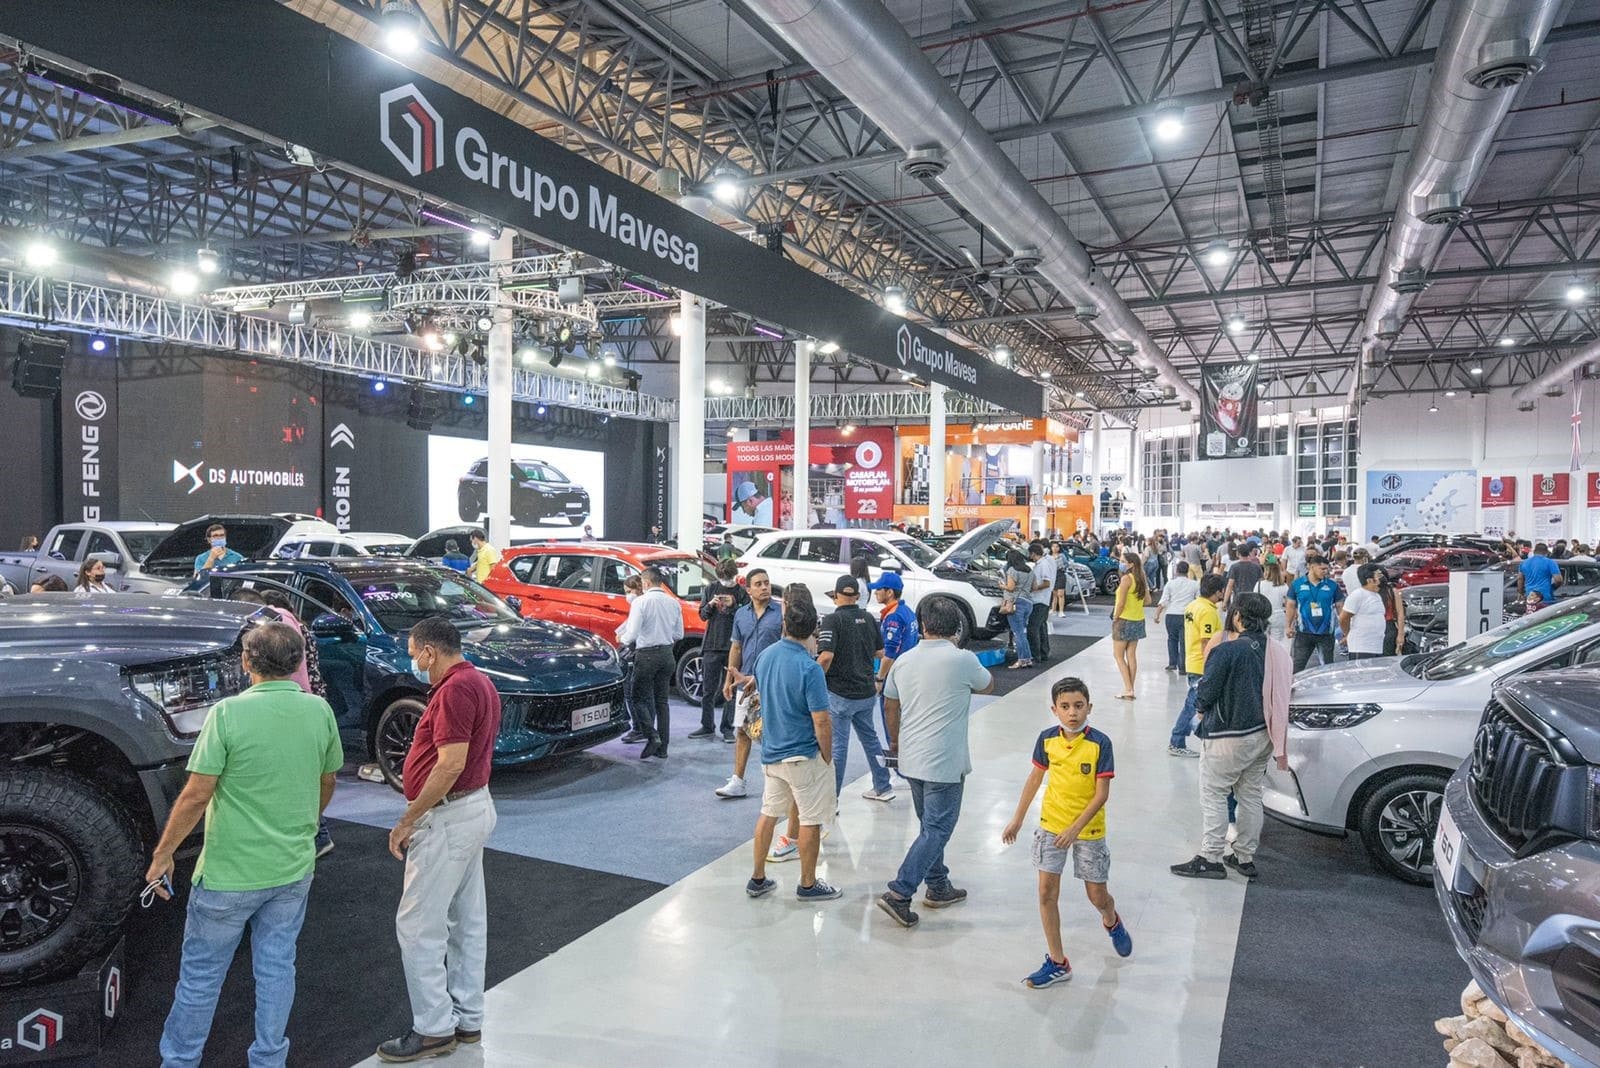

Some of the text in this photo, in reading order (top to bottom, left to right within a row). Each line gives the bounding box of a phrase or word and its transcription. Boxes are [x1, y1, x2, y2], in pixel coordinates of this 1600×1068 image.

[455, 126, 699, 272] Grupo Mavesa
[913, 336, 977, 384] Grupo Mavesa
[81, 425, 100, 496] FENG
[208, 468, 304, 487] DS AUTOMOBILES
[1204, 624, 1212, 633] 3
